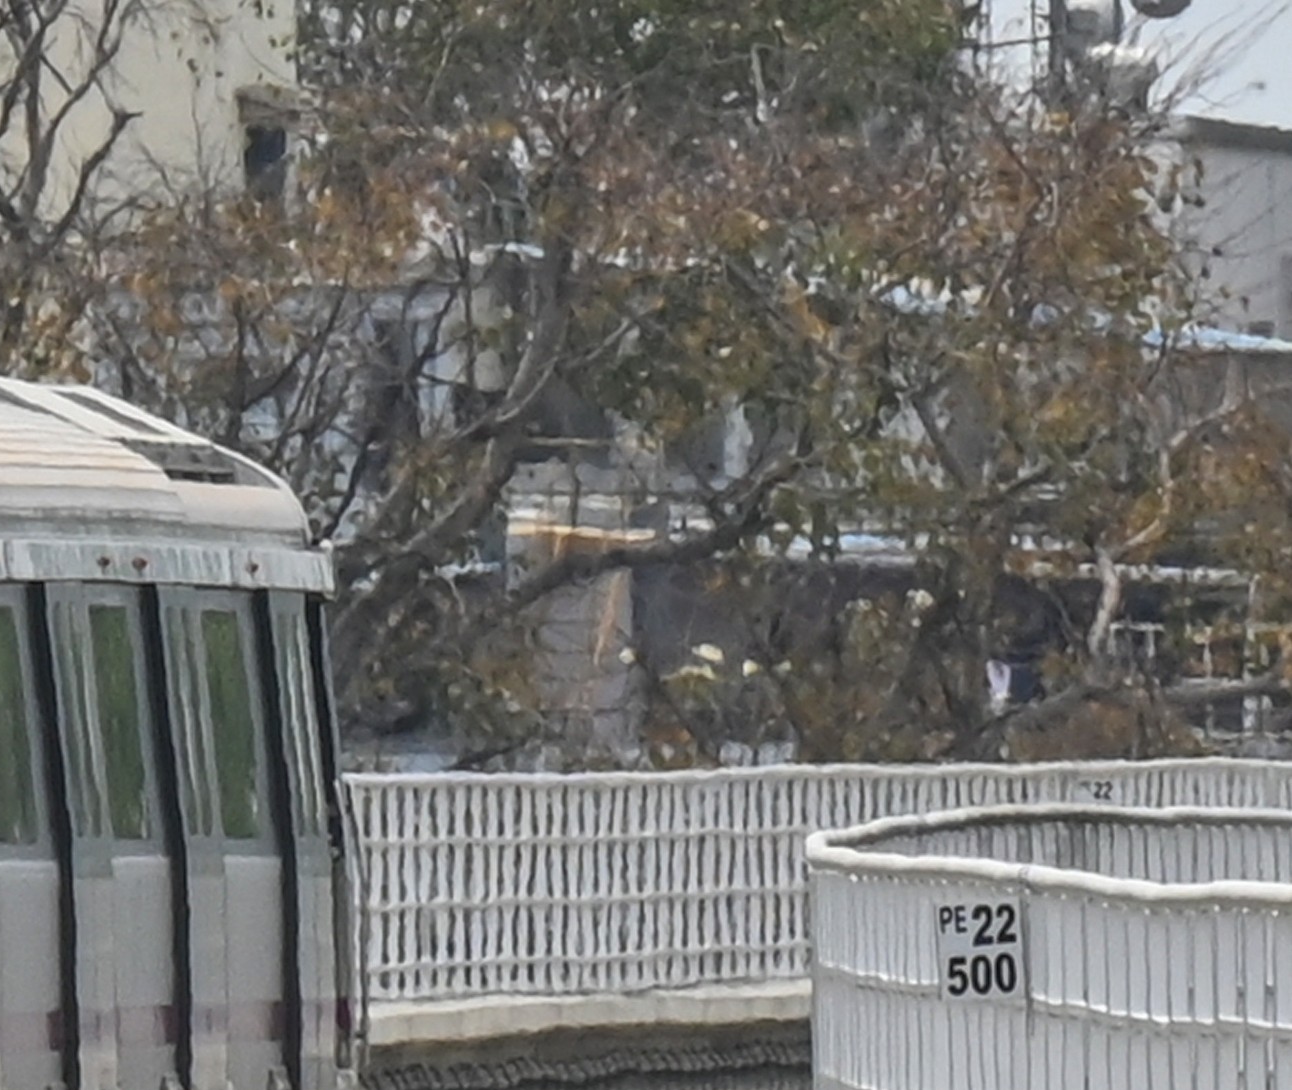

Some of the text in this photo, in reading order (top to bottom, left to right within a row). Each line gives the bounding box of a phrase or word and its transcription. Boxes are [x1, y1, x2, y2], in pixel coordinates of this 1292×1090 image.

[1094, 781, 1113, 800] 22
[939, 903, 1017, 947] PE 22
[948, 952, 1017, 996] 500
